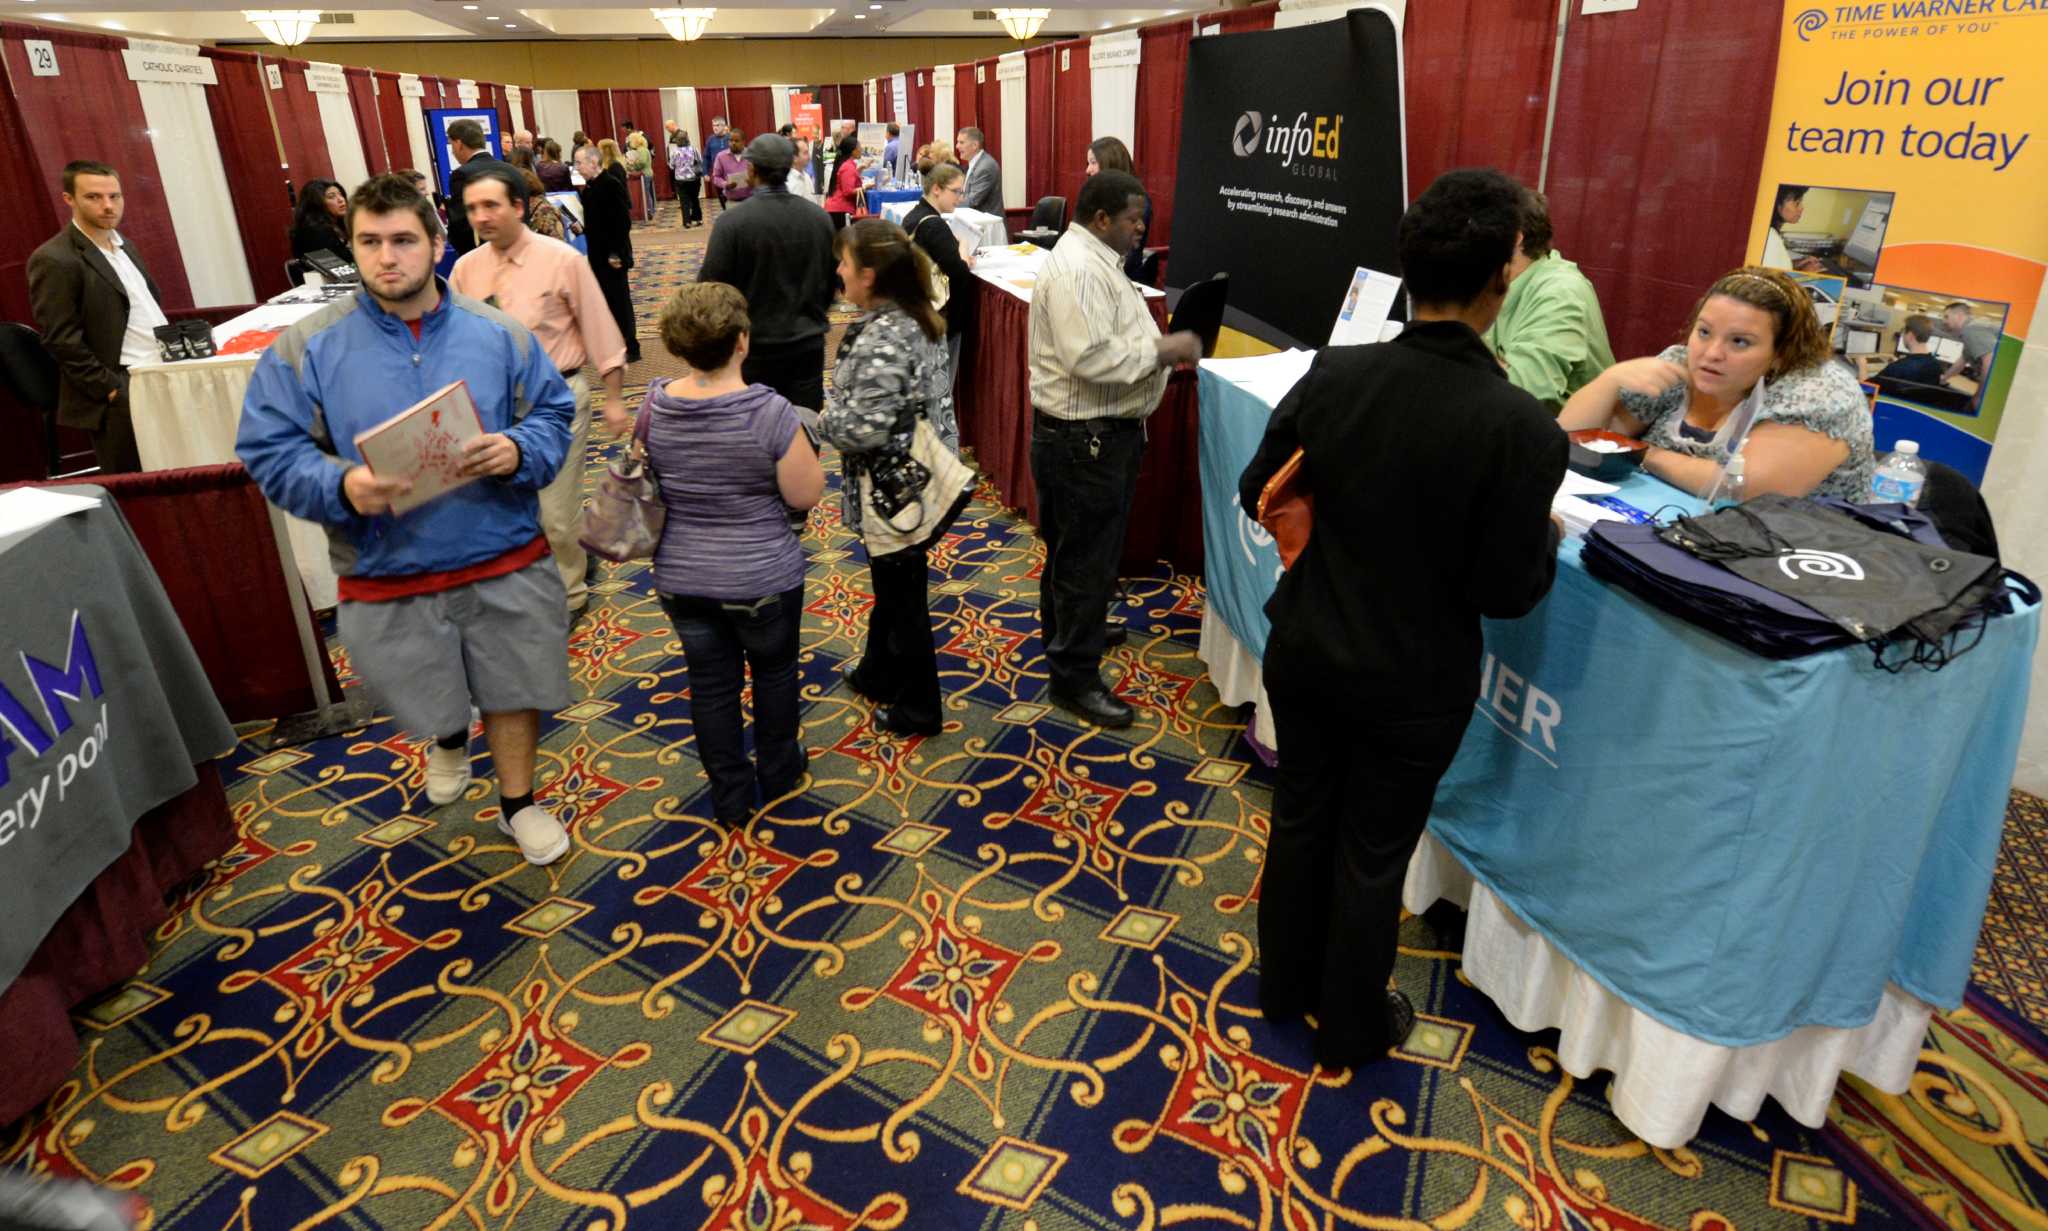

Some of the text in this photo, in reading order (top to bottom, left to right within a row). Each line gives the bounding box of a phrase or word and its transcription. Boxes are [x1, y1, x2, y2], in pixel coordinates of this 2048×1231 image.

[1834, 3, 1887, 23] TIME
[1892, 0, 1996, 19] WARNER
[1830, 31, 1857, 40] THE
[1863, 26, 1919, 39] POWER
[1926, 24, 1949, 36] OF
[34, 47, 53, 69] 29
[1823, 69, 2005, 107] Join our
[1786, 120, 2031, 172] team today
[1291, 163, 1339, 182] GLOBAL
[1219, 185, 1347, 215] Accelerating research, discovery, and answers
[1227, 198, 1339, 228] by streamlining research administration
